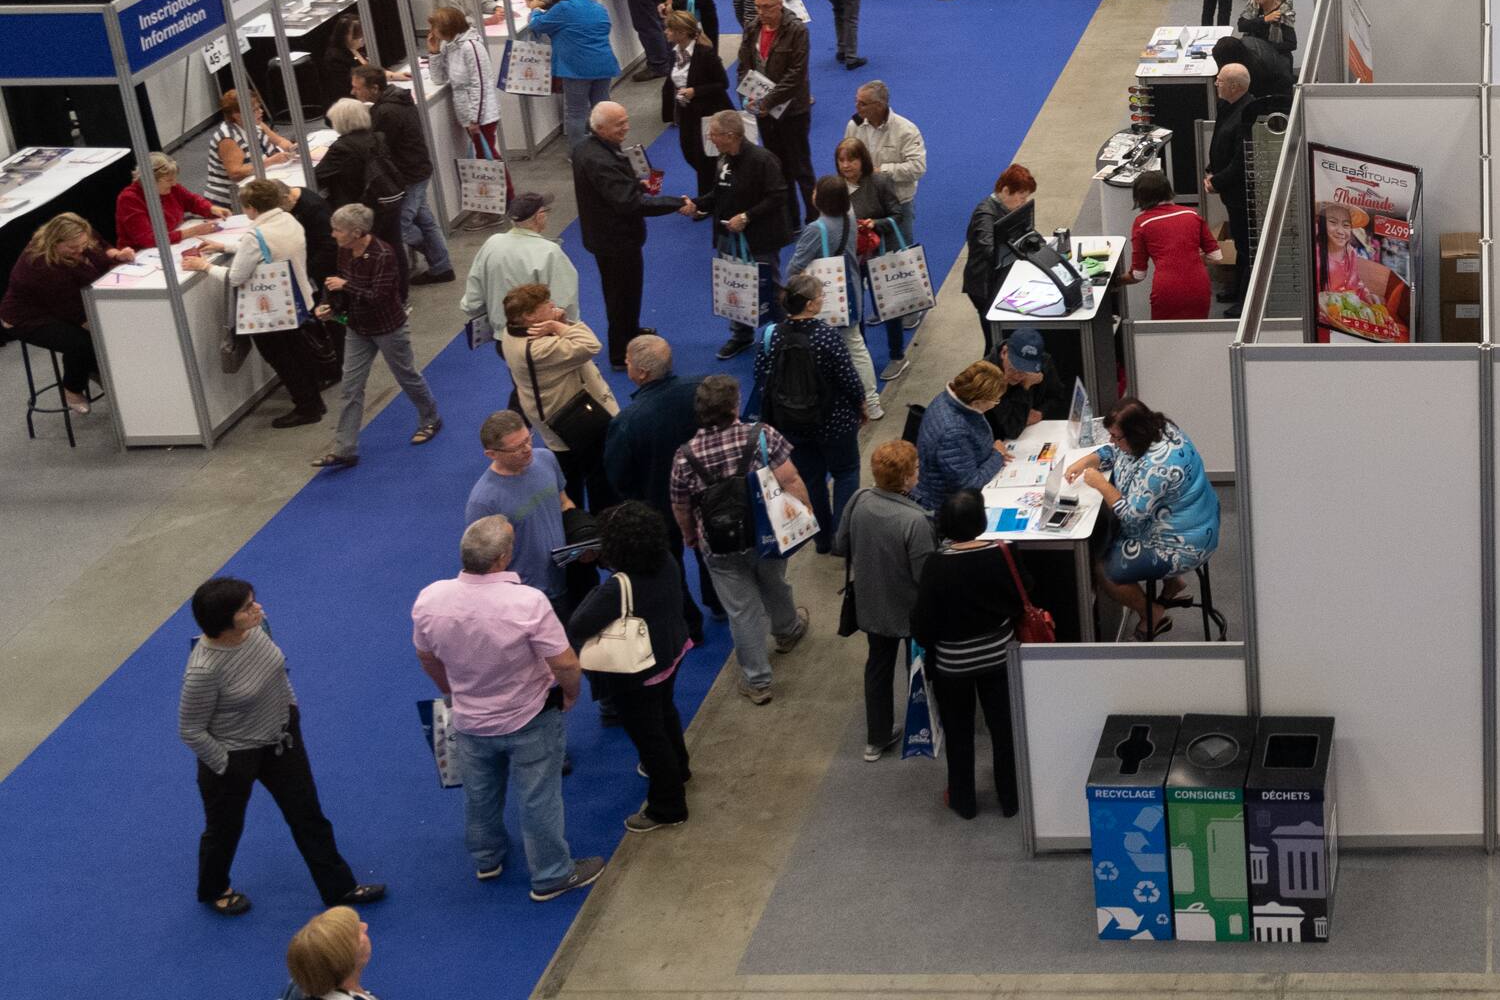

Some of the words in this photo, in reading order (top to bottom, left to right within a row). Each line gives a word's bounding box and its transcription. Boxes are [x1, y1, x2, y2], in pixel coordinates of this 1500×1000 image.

[140, 7, 206, 52] Information
[519, 55, 541, 64] Lobe
[472, 173, 496, 181] Lobe
[1384, 223, 1409, 239] 2499
[885, 270, 915, 282] Lobe
[250, 283, 277, 292] Lobe
[723, 278, 749, 290] Lobe
[1095, 789, 1156, 799] RECYCLAGE
[1174, 790, 1236, 800] CONSIGNES
[1261, 791, 1311, 801] DÉCHETS
